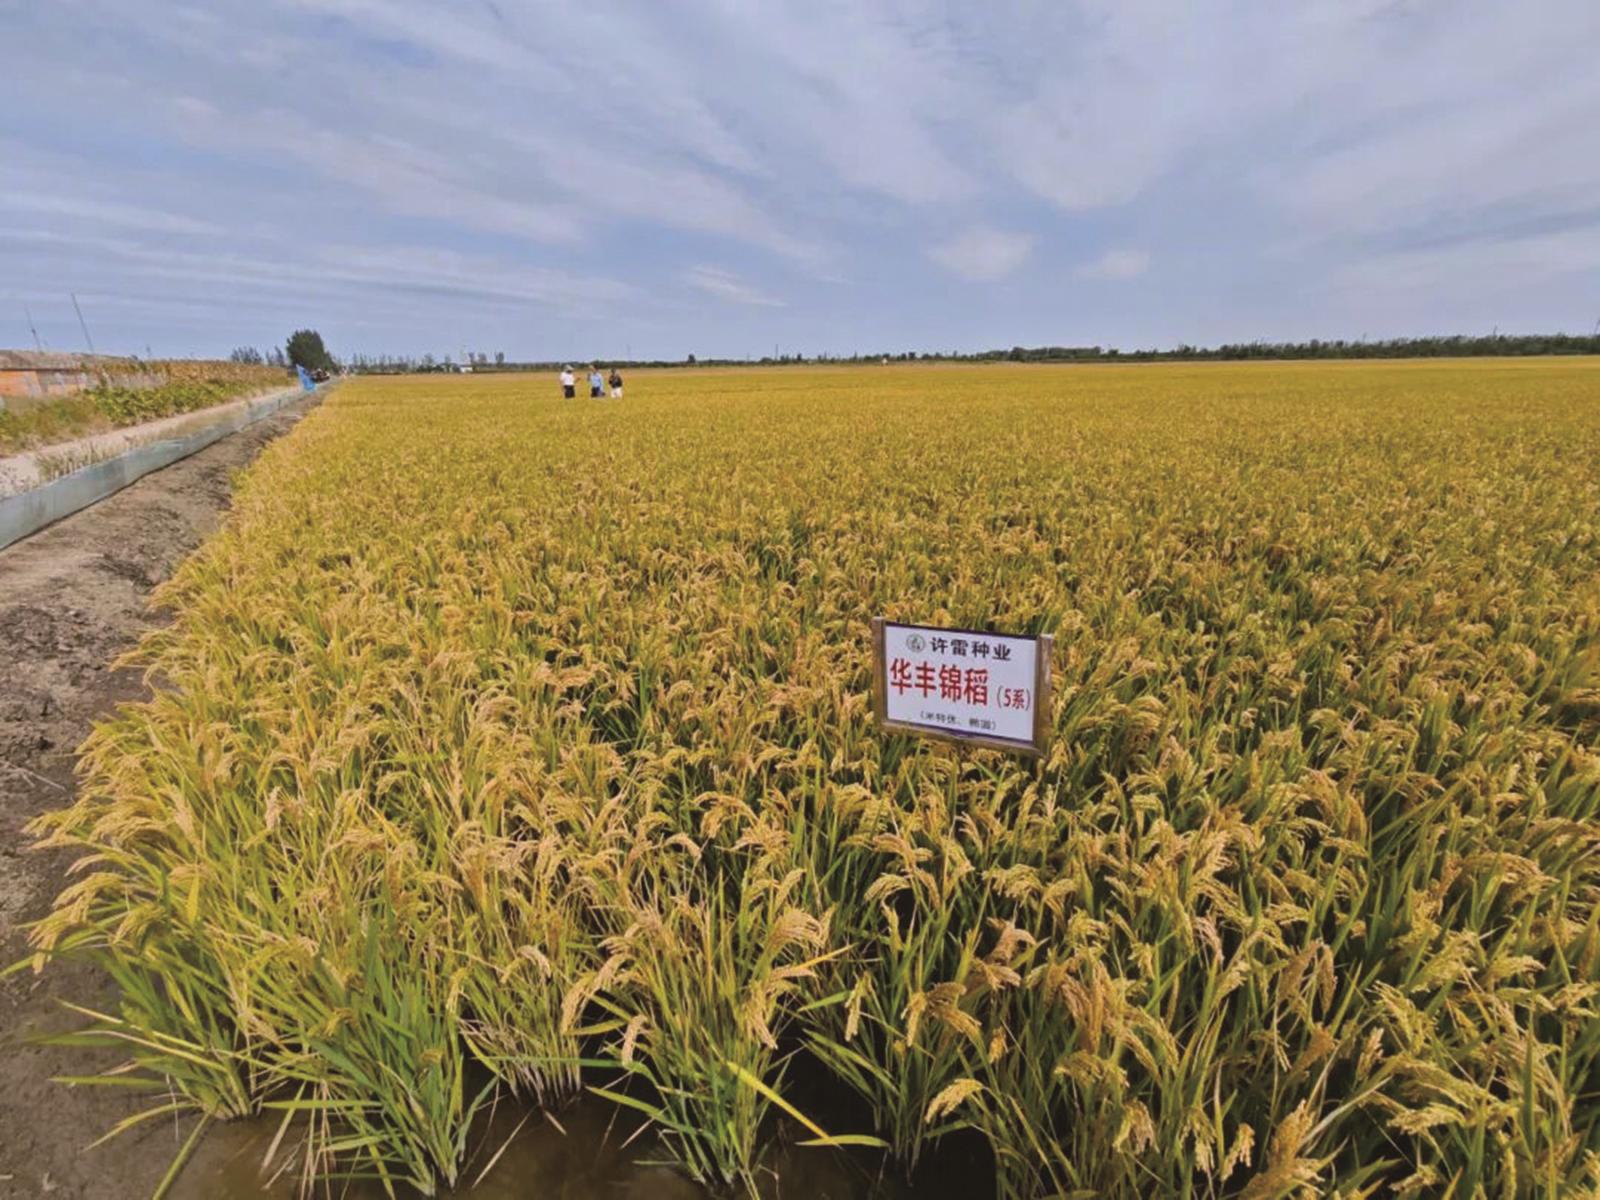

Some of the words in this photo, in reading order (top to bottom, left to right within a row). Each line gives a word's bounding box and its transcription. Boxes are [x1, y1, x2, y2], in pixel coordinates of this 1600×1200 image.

[930, 636, 1011, 661] 许雷种业
[890, 657, 988, 706] 华丰锦稻
